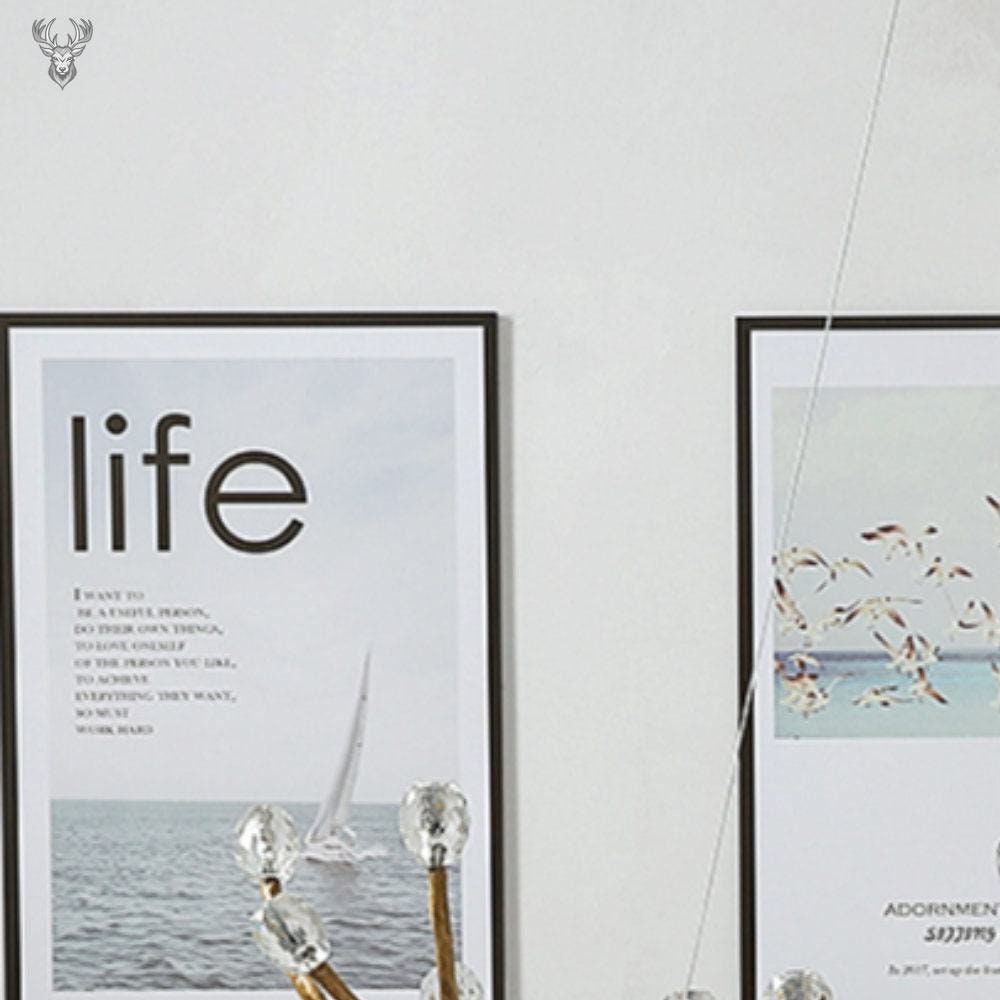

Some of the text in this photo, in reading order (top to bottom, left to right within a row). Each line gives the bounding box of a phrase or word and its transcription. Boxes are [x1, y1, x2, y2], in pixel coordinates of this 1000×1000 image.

[71, 413, 308, 553] life
[74, 588, 145, 601] I WANT TO
[74, 625, 94, 634] DO
[99, 625, 133, 634] THEIR
[138, 625, 168, 634] OWN
[76, 725, 153, 735] WORK HARD
